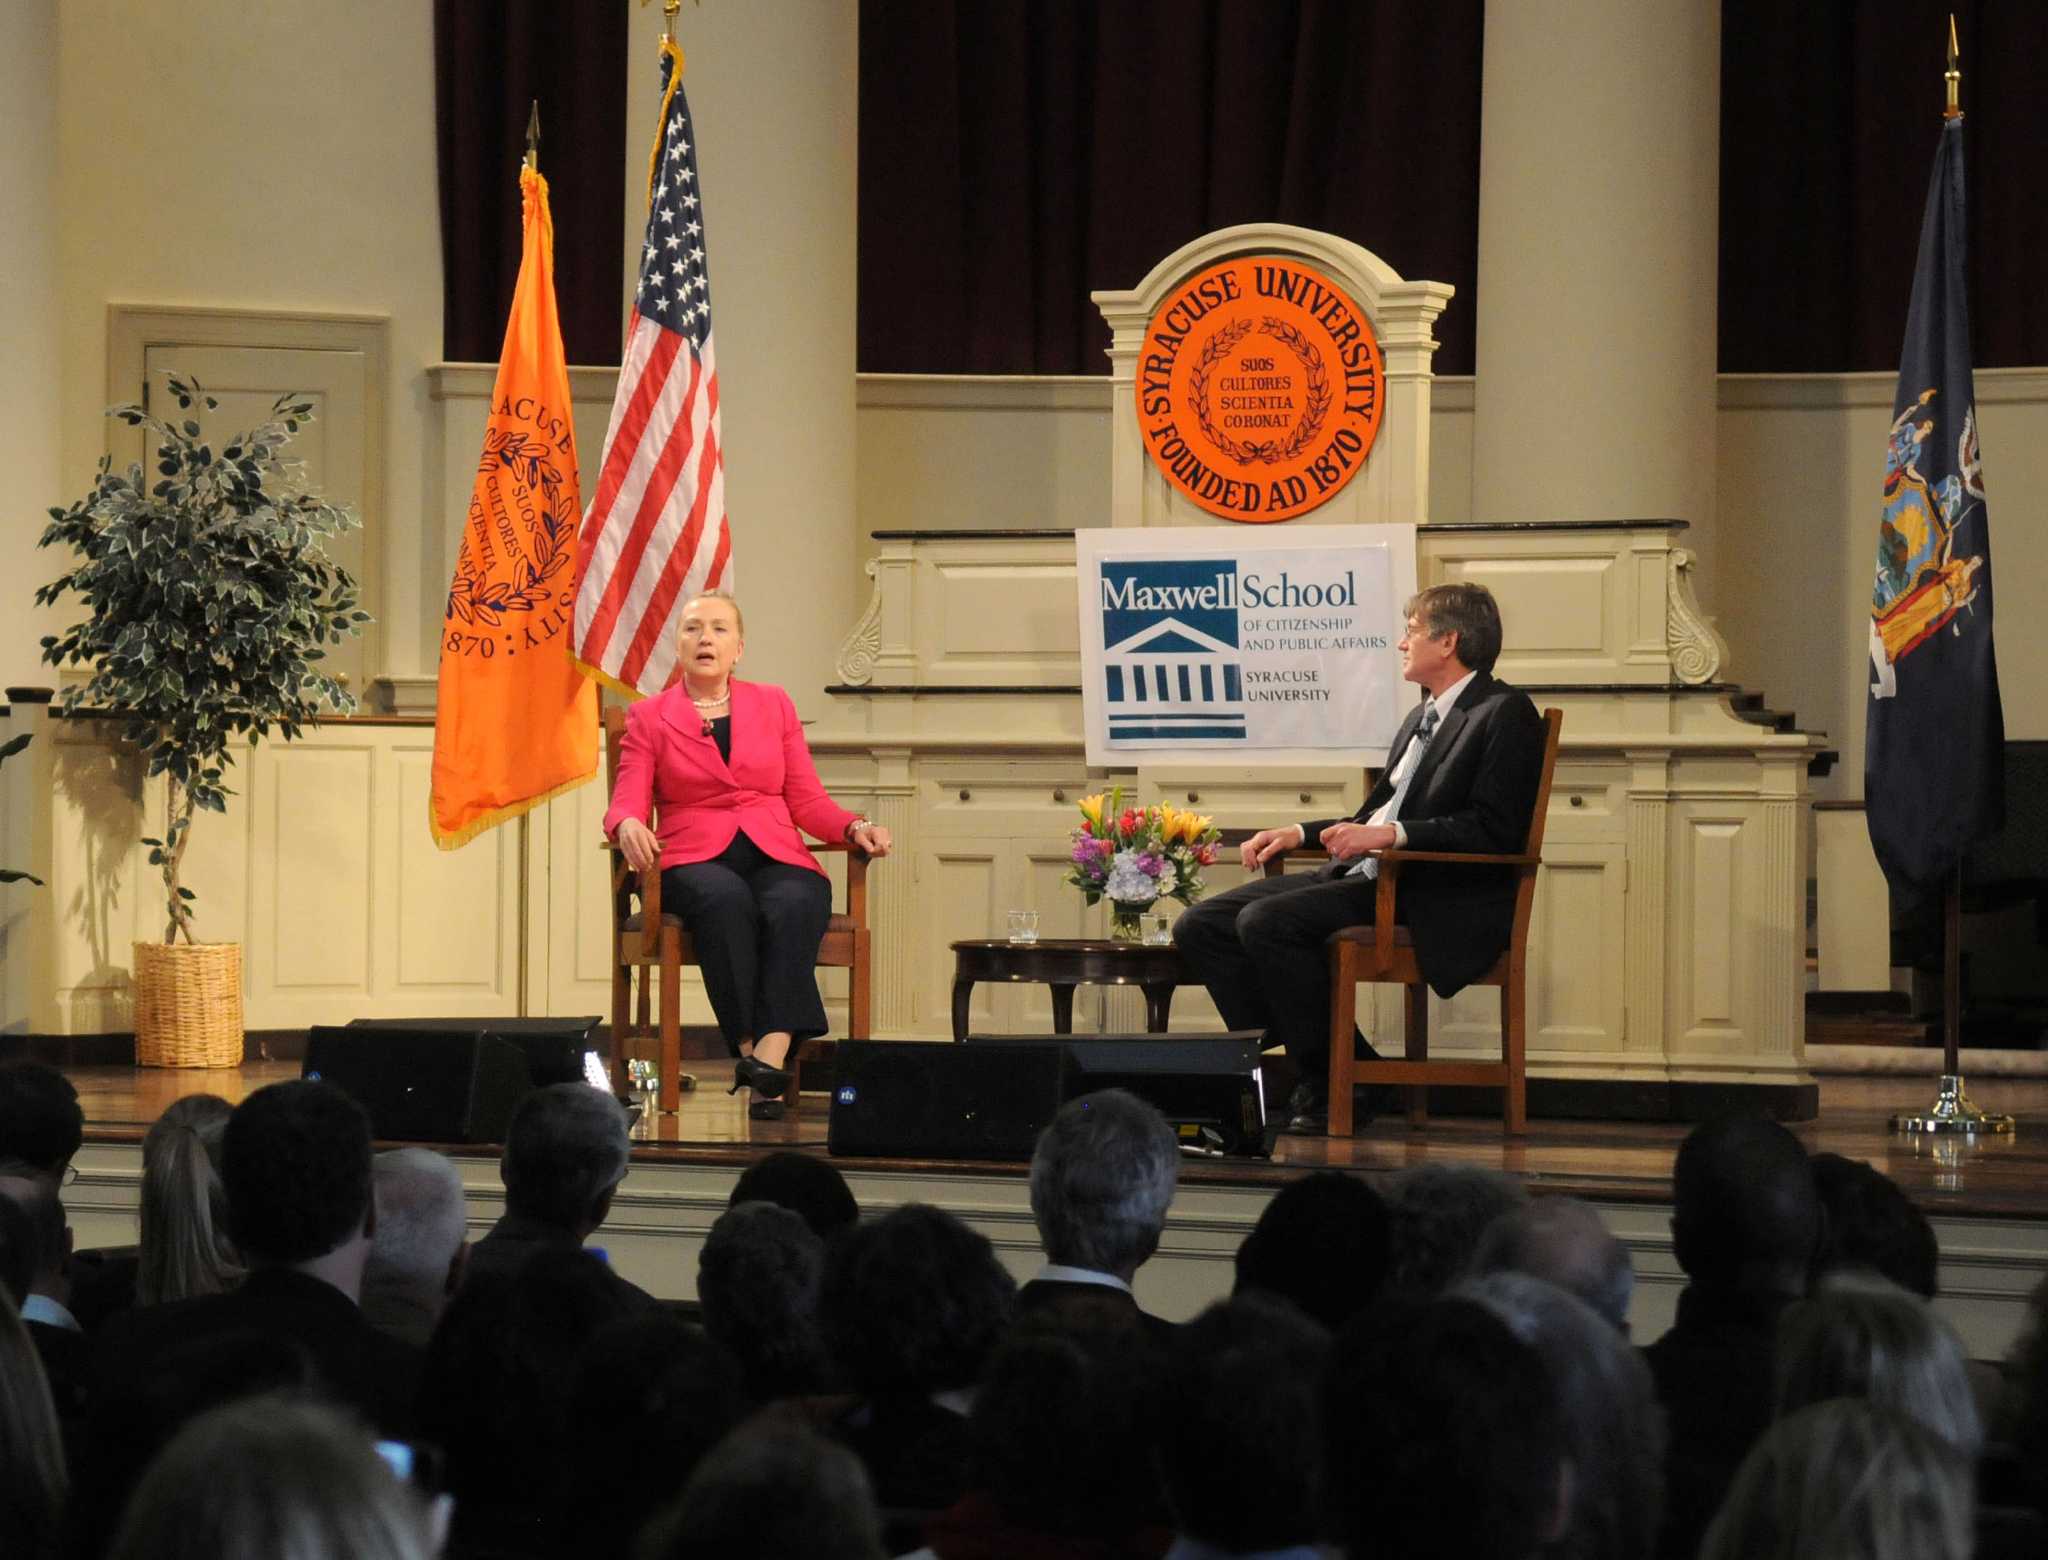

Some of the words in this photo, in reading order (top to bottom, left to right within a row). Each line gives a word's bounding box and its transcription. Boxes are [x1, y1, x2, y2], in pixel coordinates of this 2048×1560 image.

[1144, 270, 1241, 415] SYRACUSE
[1254, 266, 1375, 423] UNIVERSITY
[1240, 357, 1275, 373] SUOS
[1219, 375, 1292, 392] CULTORES
[1220, 395, 1295, 410] SCIENTIA
[491, 395, 570, 455] ACUSE
[1223, 413, 1291, 429] CORONAT
[1151, 422, 1260, 511] FOUNDED
[1265, 475, 1308, 512] AD
[1304, 428, 1362, 494] 1870
[486, 475, 522, 558] CULTORES
[511, 484, 539, 533] SUOS
[1101, 573, 1237, 611] Maxwell
[1241, 570, 1357, 609] School
[1243, 619, 1263, 632] OF
[1265, 618, 1353, 632] CITIZENSHIP
[1244, 638, 1275, 651] AND
[1279, 638, 1328, 650] PUBLIC
[1331, 636, 1387, 649] AFFAIRS
[1246, 670, 1319, 684] SYRACUSE
[1248, 689, 1331, 702] UNIVERSITY
